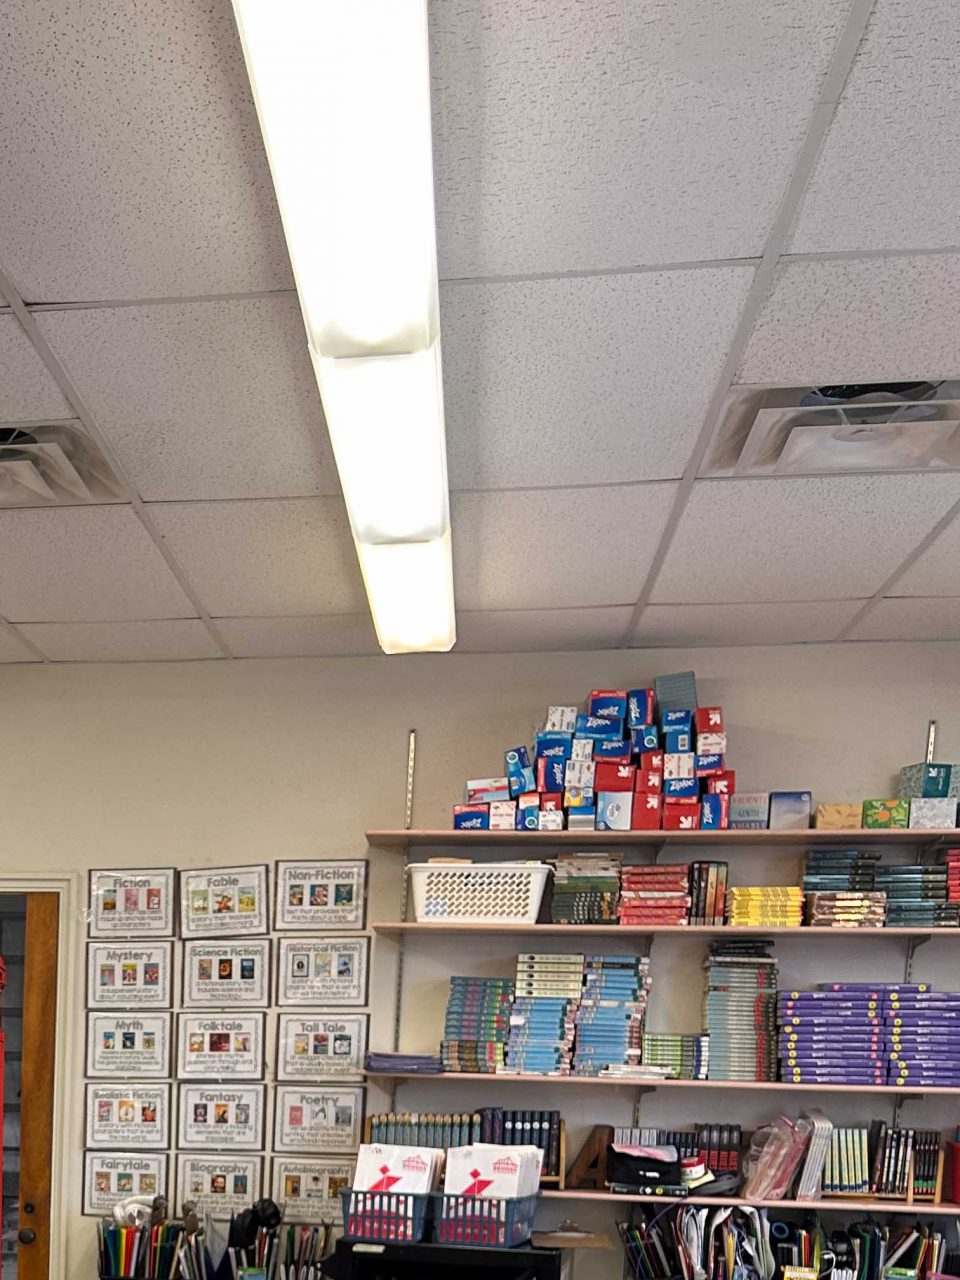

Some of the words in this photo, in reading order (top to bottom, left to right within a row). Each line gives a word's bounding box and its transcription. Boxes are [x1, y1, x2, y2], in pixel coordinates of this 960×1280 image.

[669, 779, 695, 791] Ziploc
[703, 801, 713, 825] Ziploc
[288, 870, 354, 880] Non-Fiction
[113, 879, 150, 888] Fiction
[207, 877, 239, 888] Fable
[106, 951, 153, 962] Mystery
[191, 948, 229, 957] Science
[230, 948, 261, 957] Fiction
[115, 1020, 143, 1031] Myth
[198, 1021, 243, 1031] Folktale
[301, 1023, 319, 1032] Tall
[322, 1023, 346, 1032] Tale
[200, 1092, 243, 1103] Fantasy
[300, 1095, 339, 1107] Poetry
[101, 1160, 150, 1171] Fairytale
[190, 1162, 248, 1174] Biography
[283, 1165, 349, 1175] Autobiography
